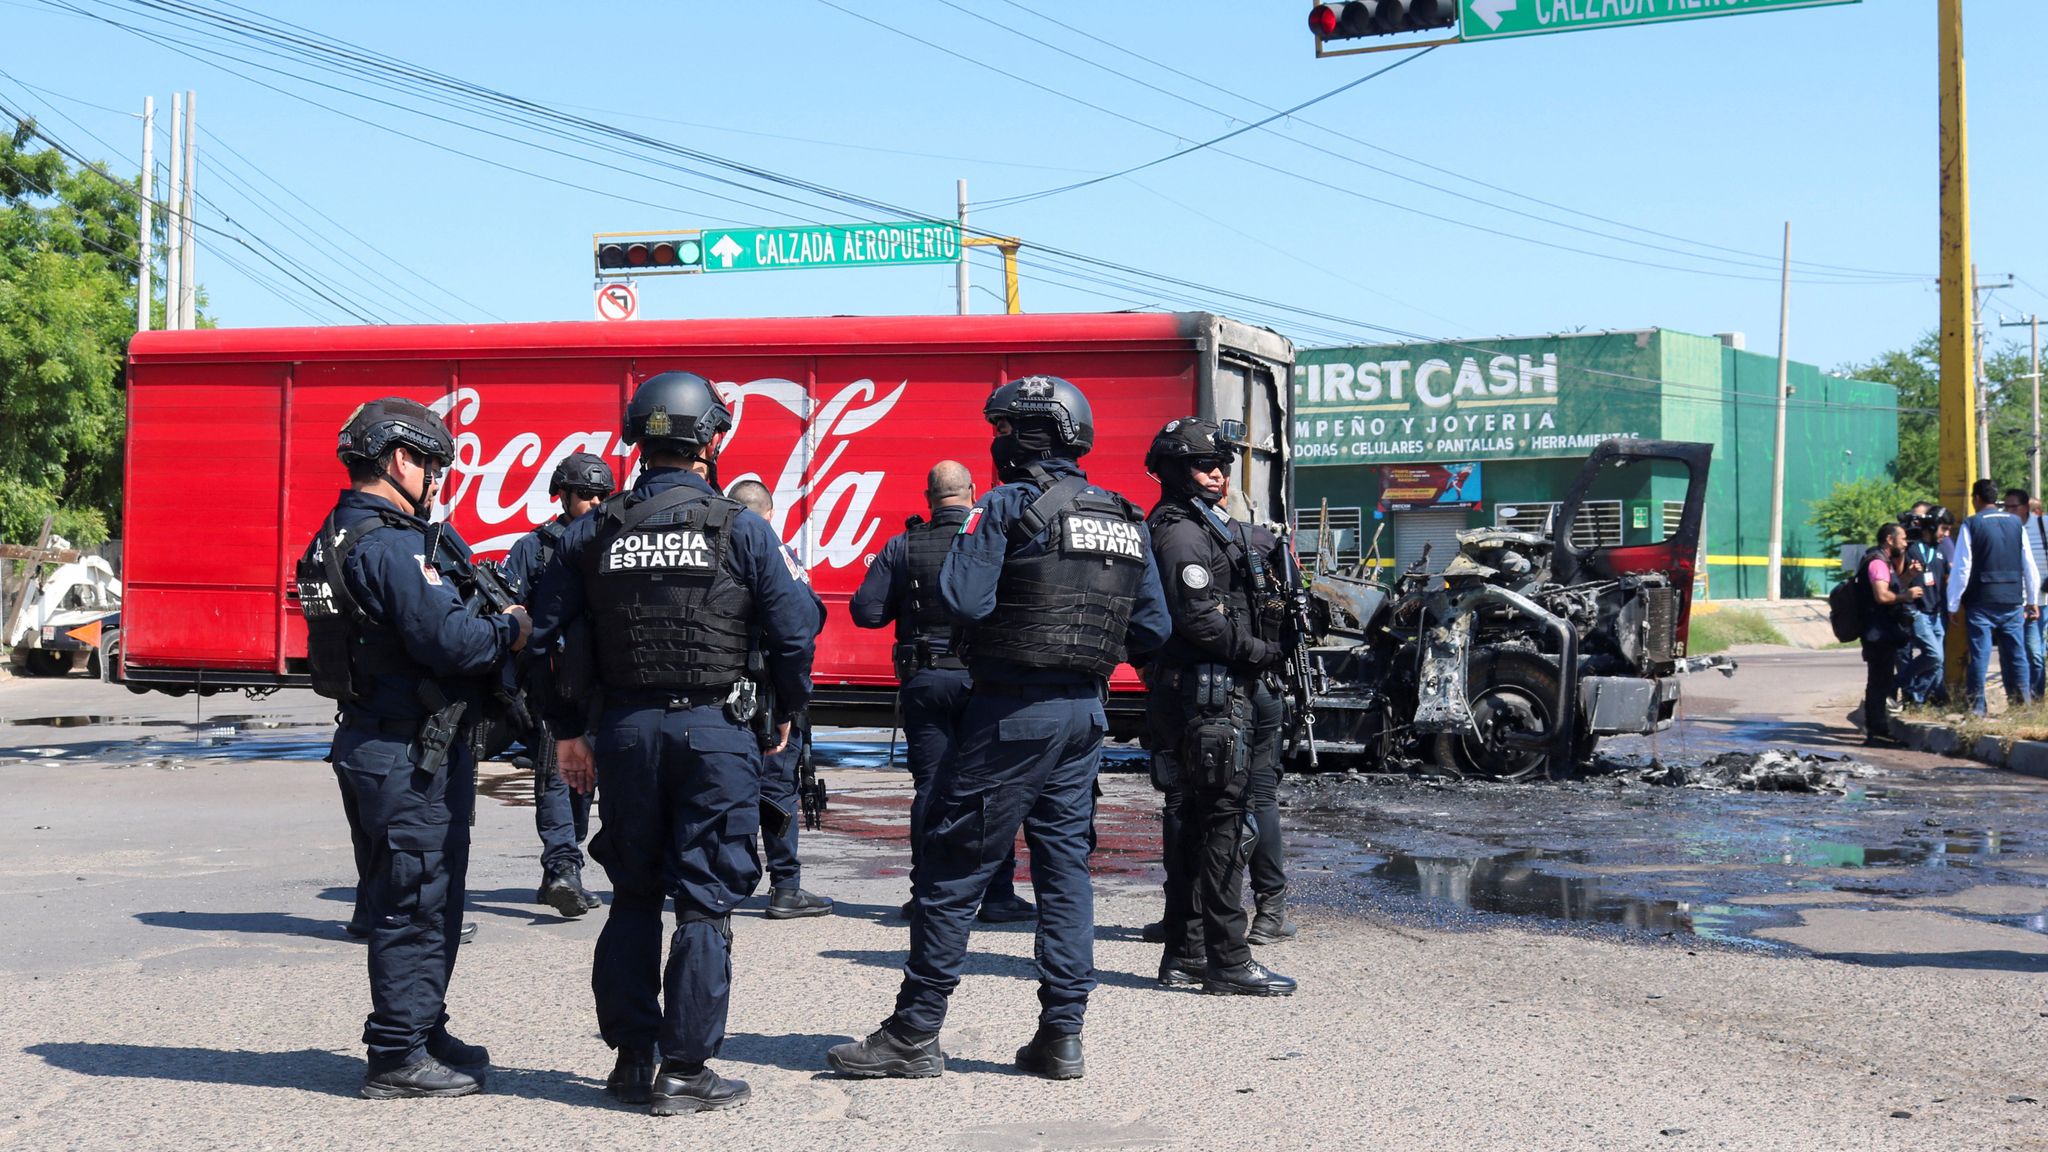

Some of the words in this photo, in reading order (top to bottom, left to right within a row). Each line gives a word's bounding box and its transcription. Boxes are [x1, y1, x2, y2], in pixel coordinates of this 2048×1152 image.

[755, 232, 836, 265] CALZADA
[843, 226, 955, 262] AEROPUERTO
[1415, 353, 1558, 408] CASH
[1295, 416, 1386, 438] MPEÑO
[1401, 417, 1415, 435] Y
[1426, 412, 1556, 433] JOYERIA
[1351, 440, 1424, 455] CELULARES
[1437, 437, 1514, 452] PANTALLAS
[1071, 533, 1143, 559] ESTATAL
[609, 550, 709, 570] ESTATAL
